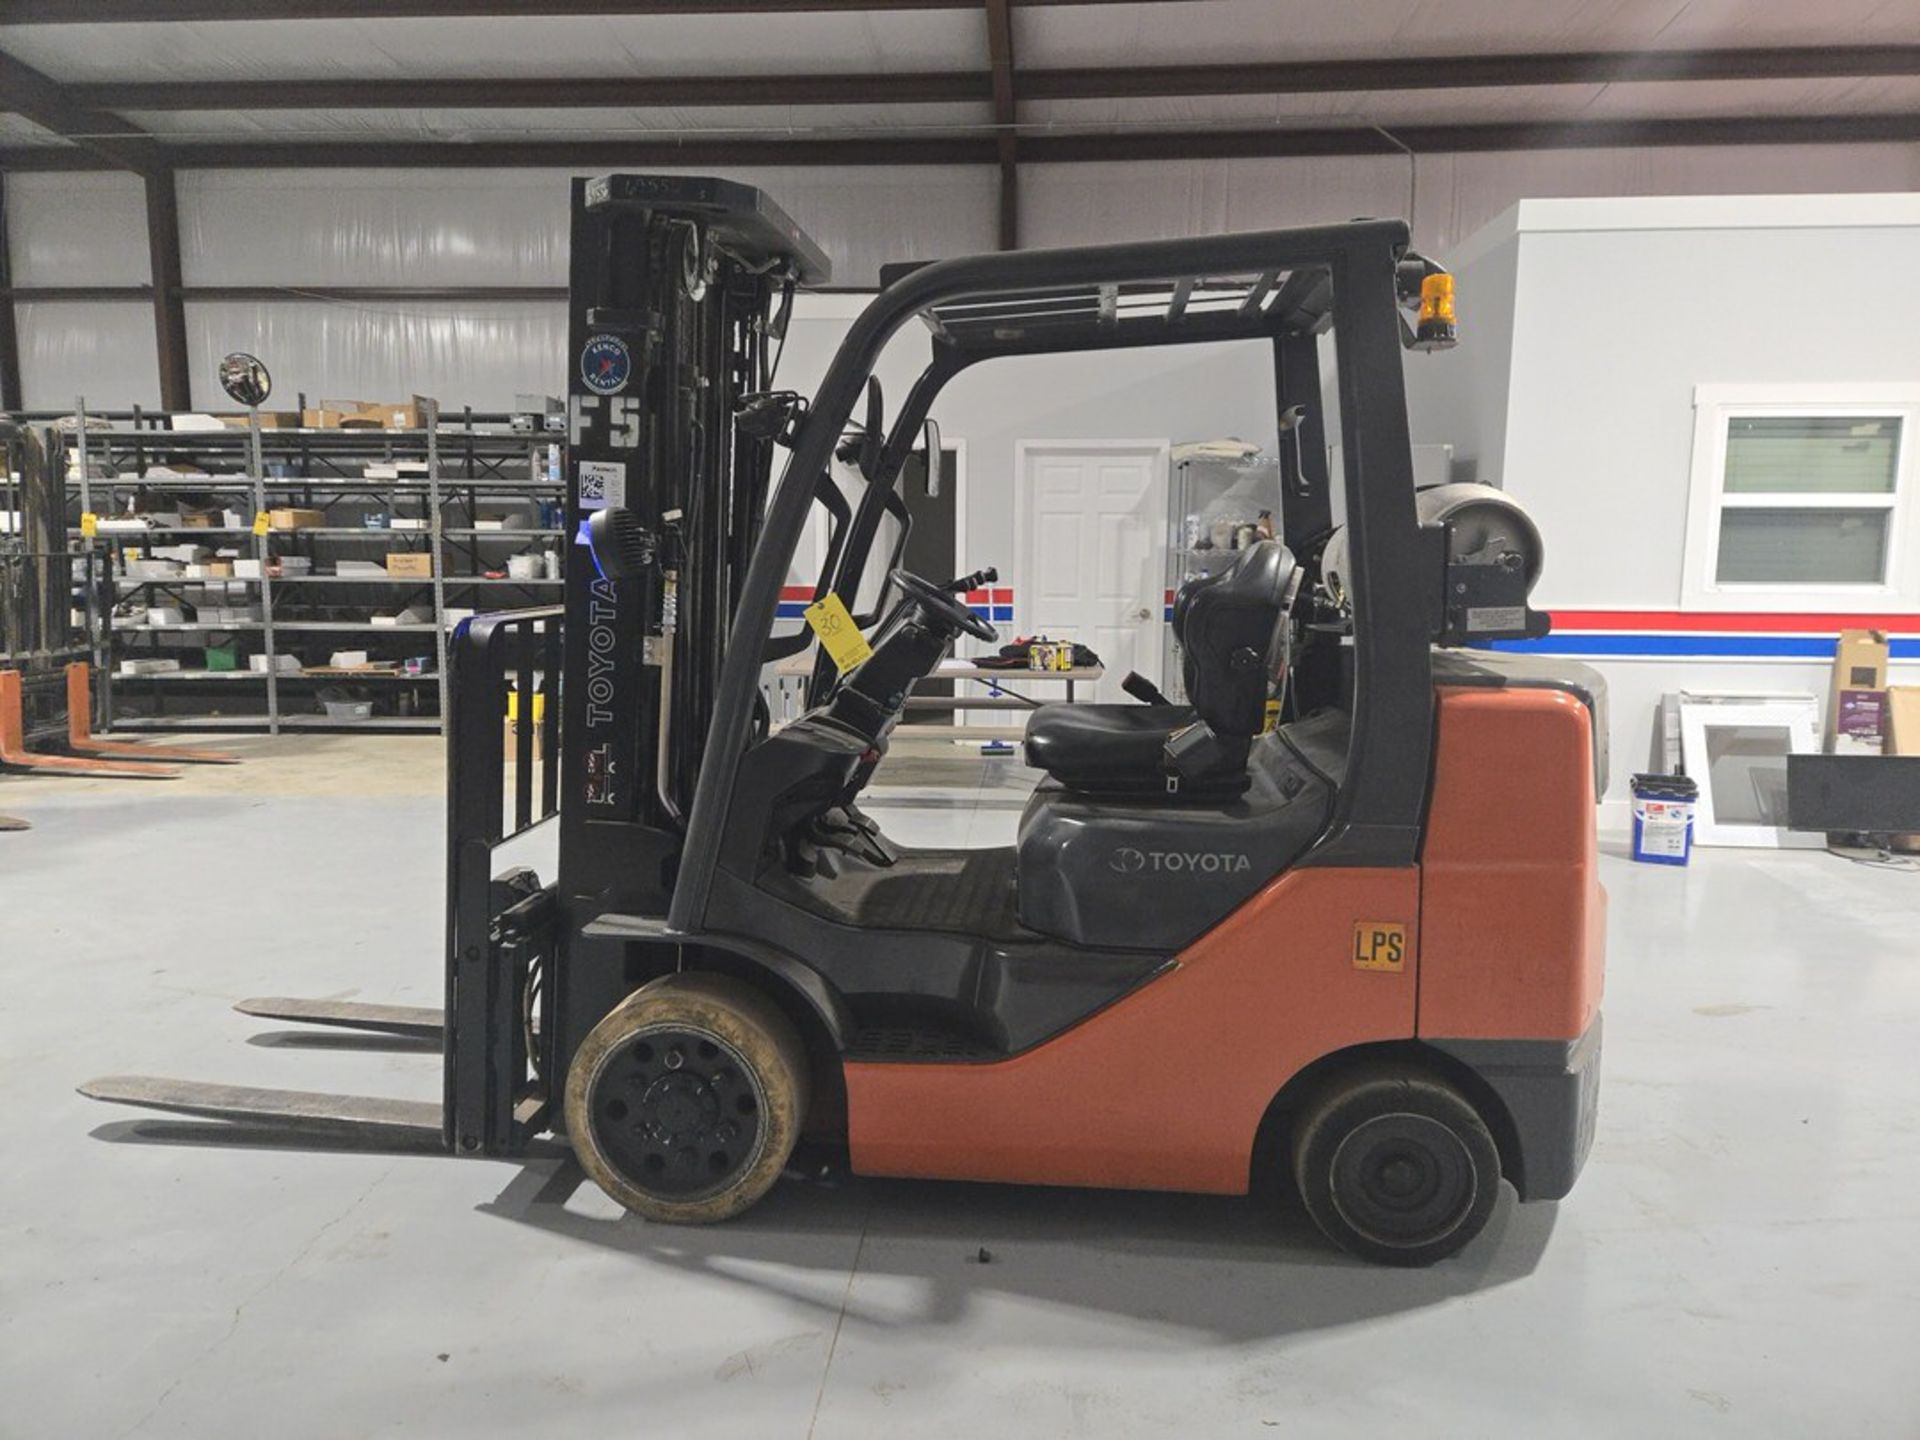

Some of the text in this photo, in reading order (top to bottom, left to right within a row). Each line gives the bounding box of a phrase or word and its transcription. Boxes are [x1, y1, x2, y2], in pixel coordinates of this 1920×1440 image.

[592, 343, 622, 356] KENCO
[589, 372, 622, 387] RENTAL
[820, 611, 842, 637] 30
[586, 577, 618, 729] TOYOTA
[1149, 852, 1251, 873] TOYOTA
[1355, 930, 1403, 963] LPS
